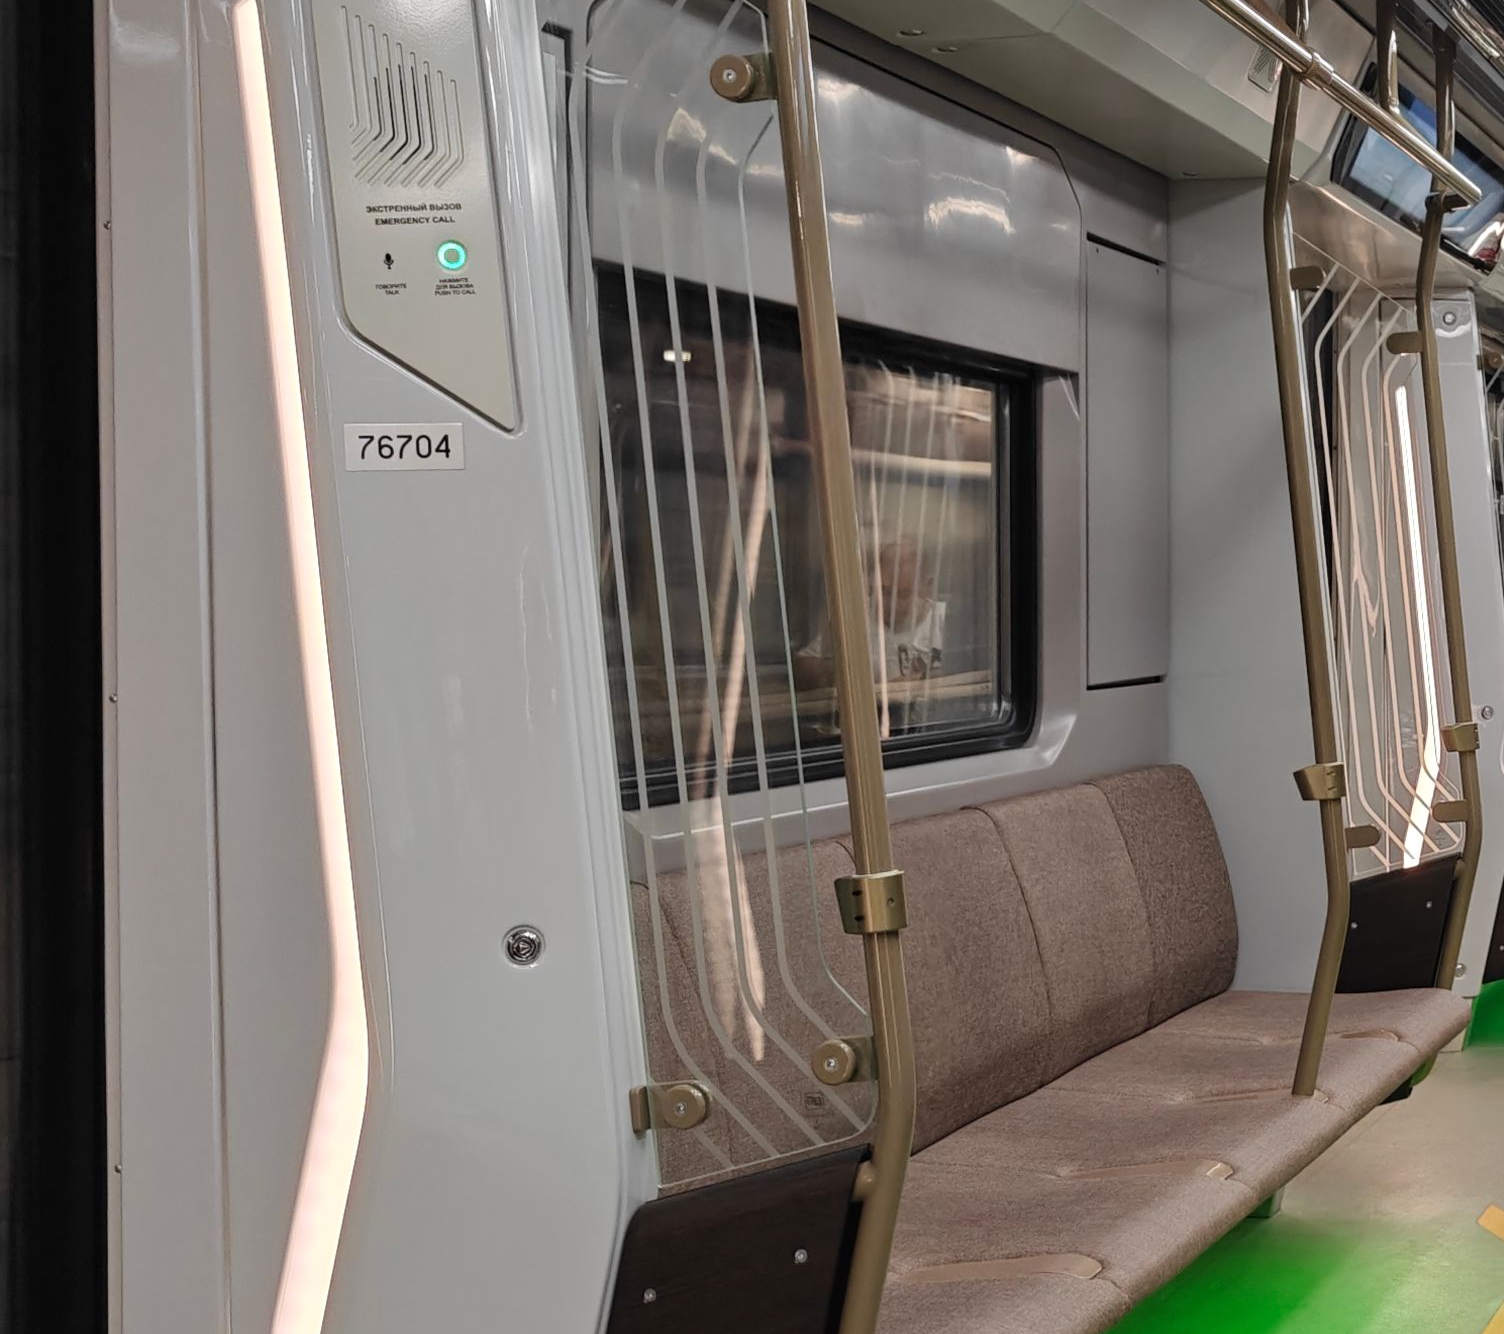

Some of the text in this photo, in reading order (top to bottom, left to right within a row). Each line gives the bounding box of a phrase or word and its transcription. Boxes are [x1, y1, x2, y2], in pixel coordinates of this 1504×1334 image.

[366, 203, 462, 213] ЭКСТРЕННЫЙ ВЫЗОВ
[375, 217, 430, 225] EMERGENCY
[358, 434, 451, 459] 76704
